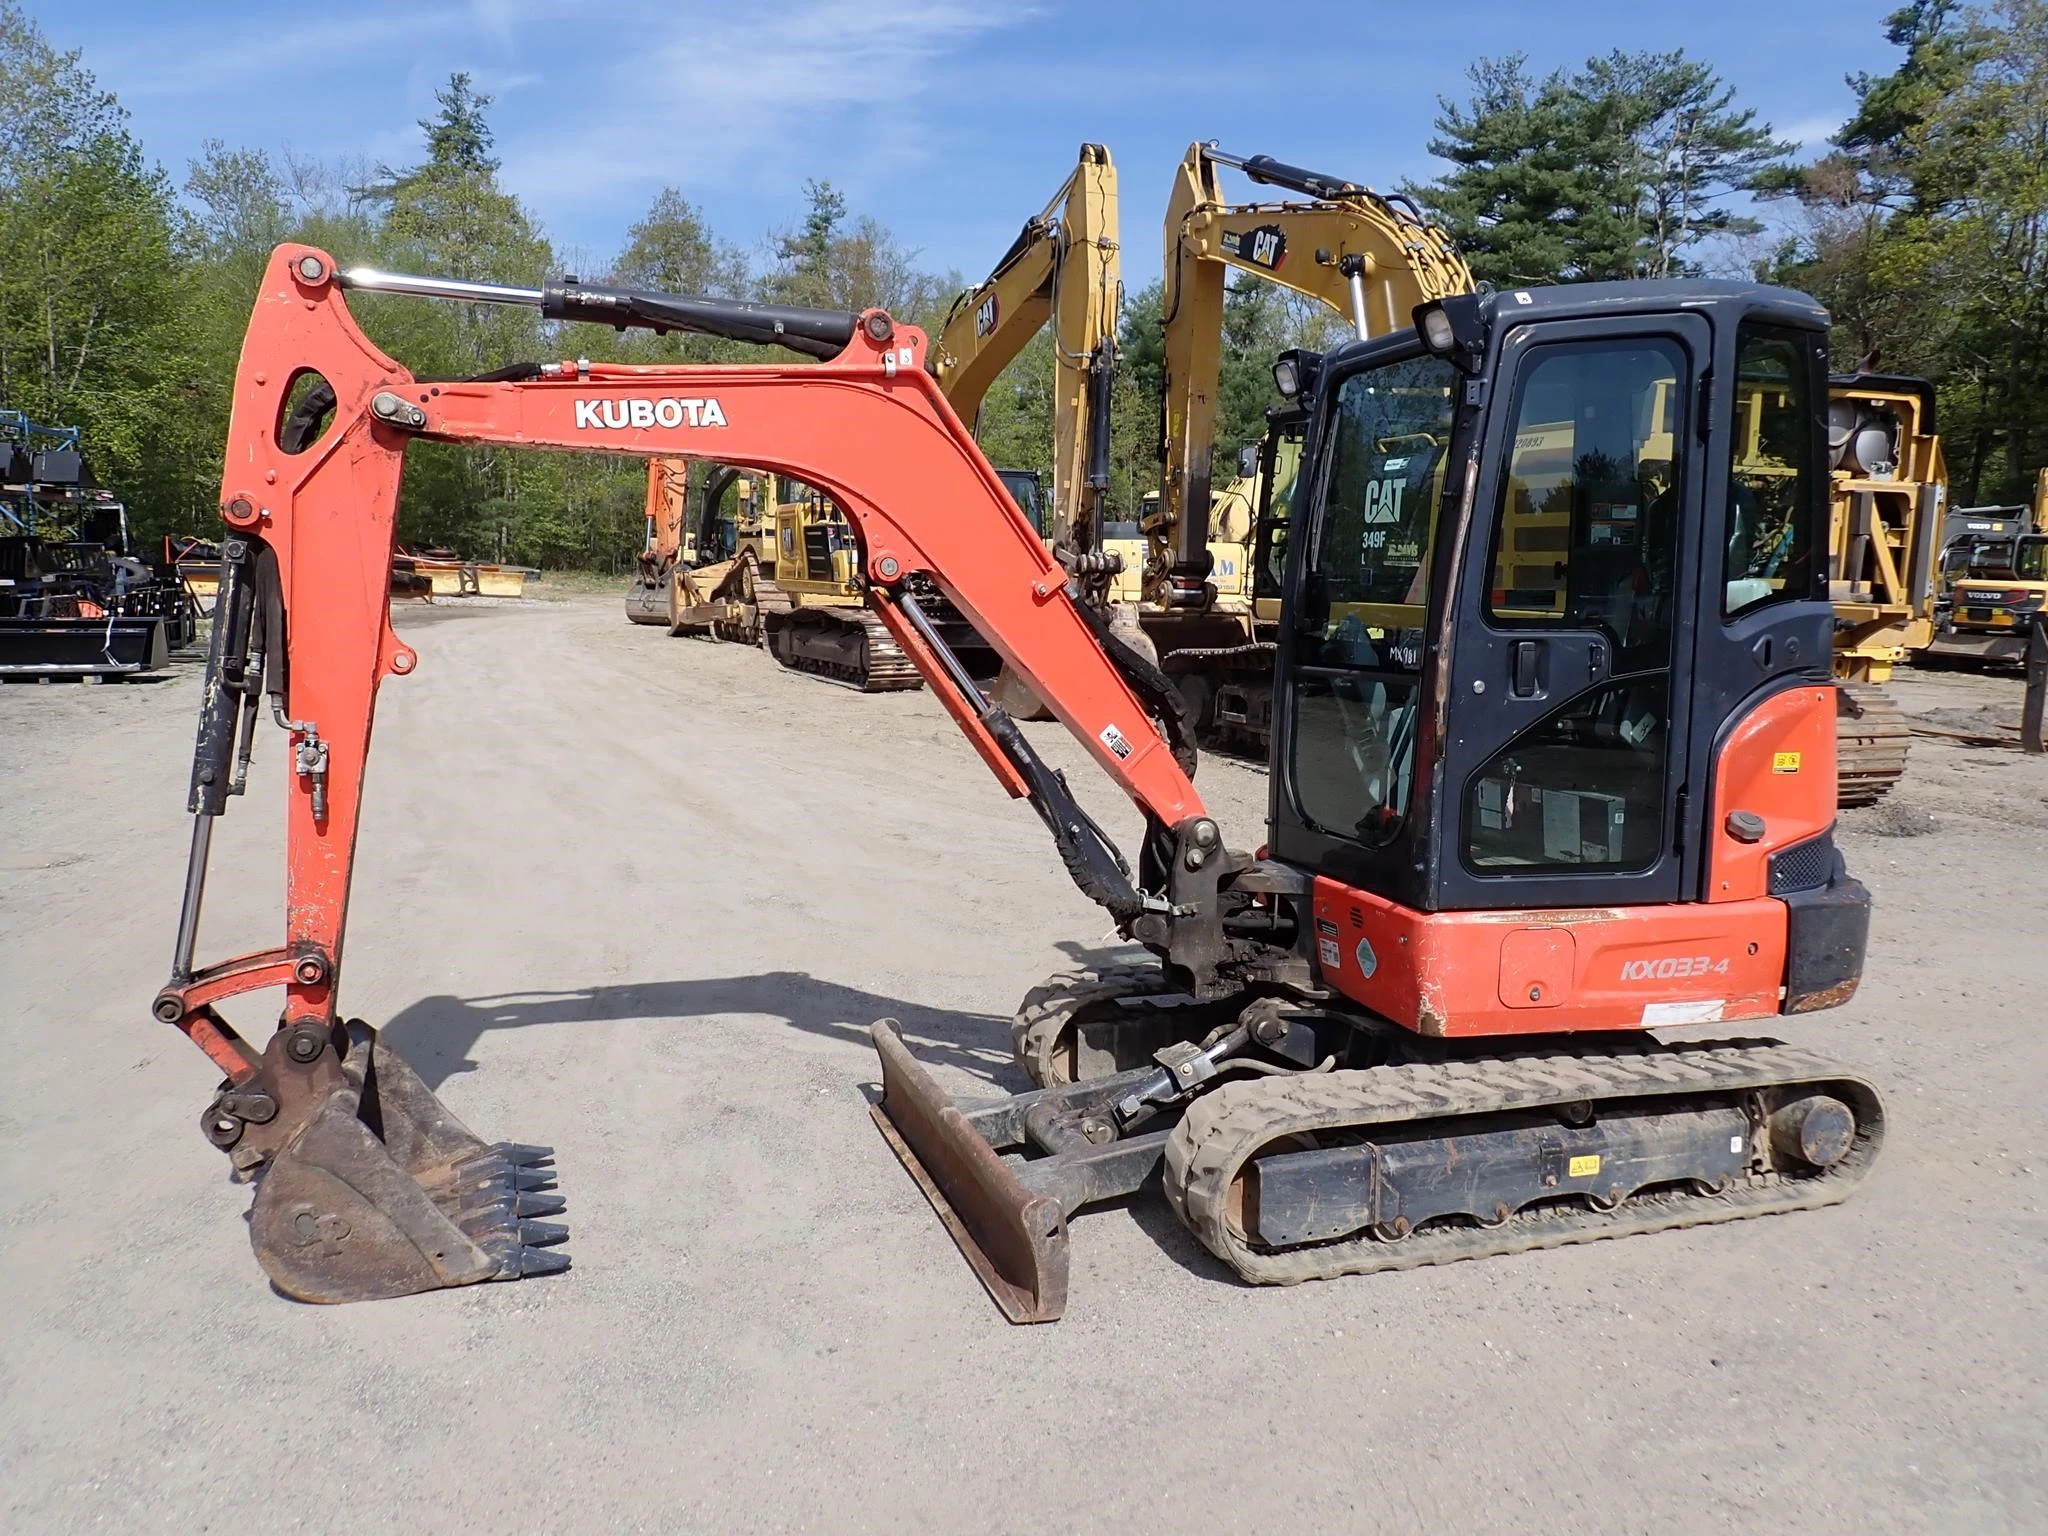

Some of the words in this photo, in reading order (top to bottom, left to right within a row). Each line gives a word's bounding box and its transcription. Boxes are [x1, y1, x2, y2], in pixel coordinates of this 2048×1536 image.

[1252, 230, 1279, 266] CAT
[976, 295, 994, 337] CAT
[574, 398, 728, 429] KUBOTA
[1364, 479, 1407, 523] CAT
[1362, 531, 1387, 549] 349F
[1620, 956, 1730, 981] KX033-4
